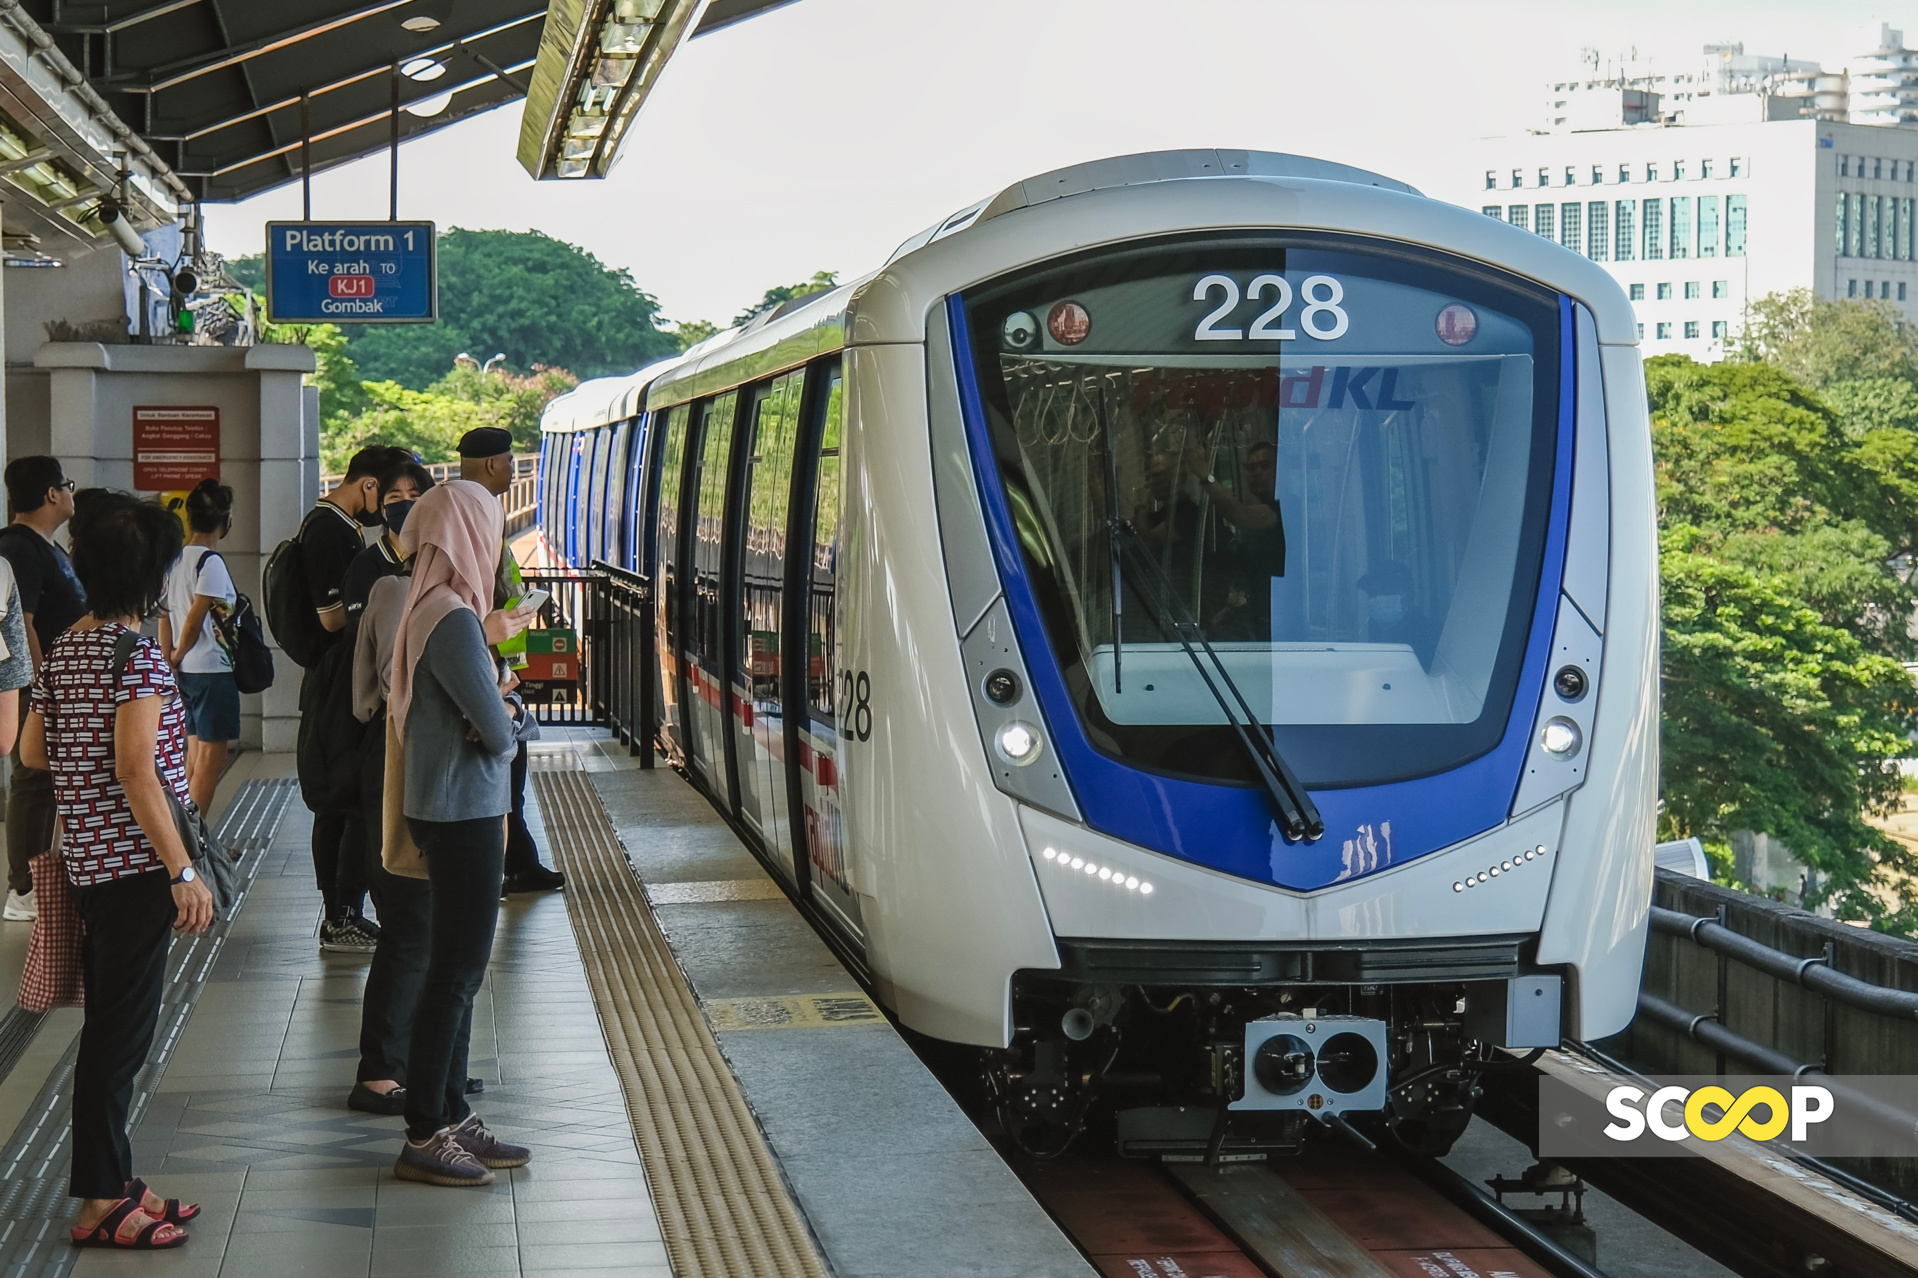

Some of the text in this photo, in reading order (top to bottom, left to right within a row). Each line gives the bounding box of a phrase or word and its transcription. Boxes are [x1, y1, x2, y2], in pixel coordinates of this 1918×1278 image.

[285, 230, 414, 251] Platform 1
[308, 259, 396, 274] Ke arah TO
[337, 279, 366, 294] KJ1
[321, 299, 383, 313] Gombak
[1193, 274, 1349, 341] 228
[525, 682, 544, 690] Tinggi
